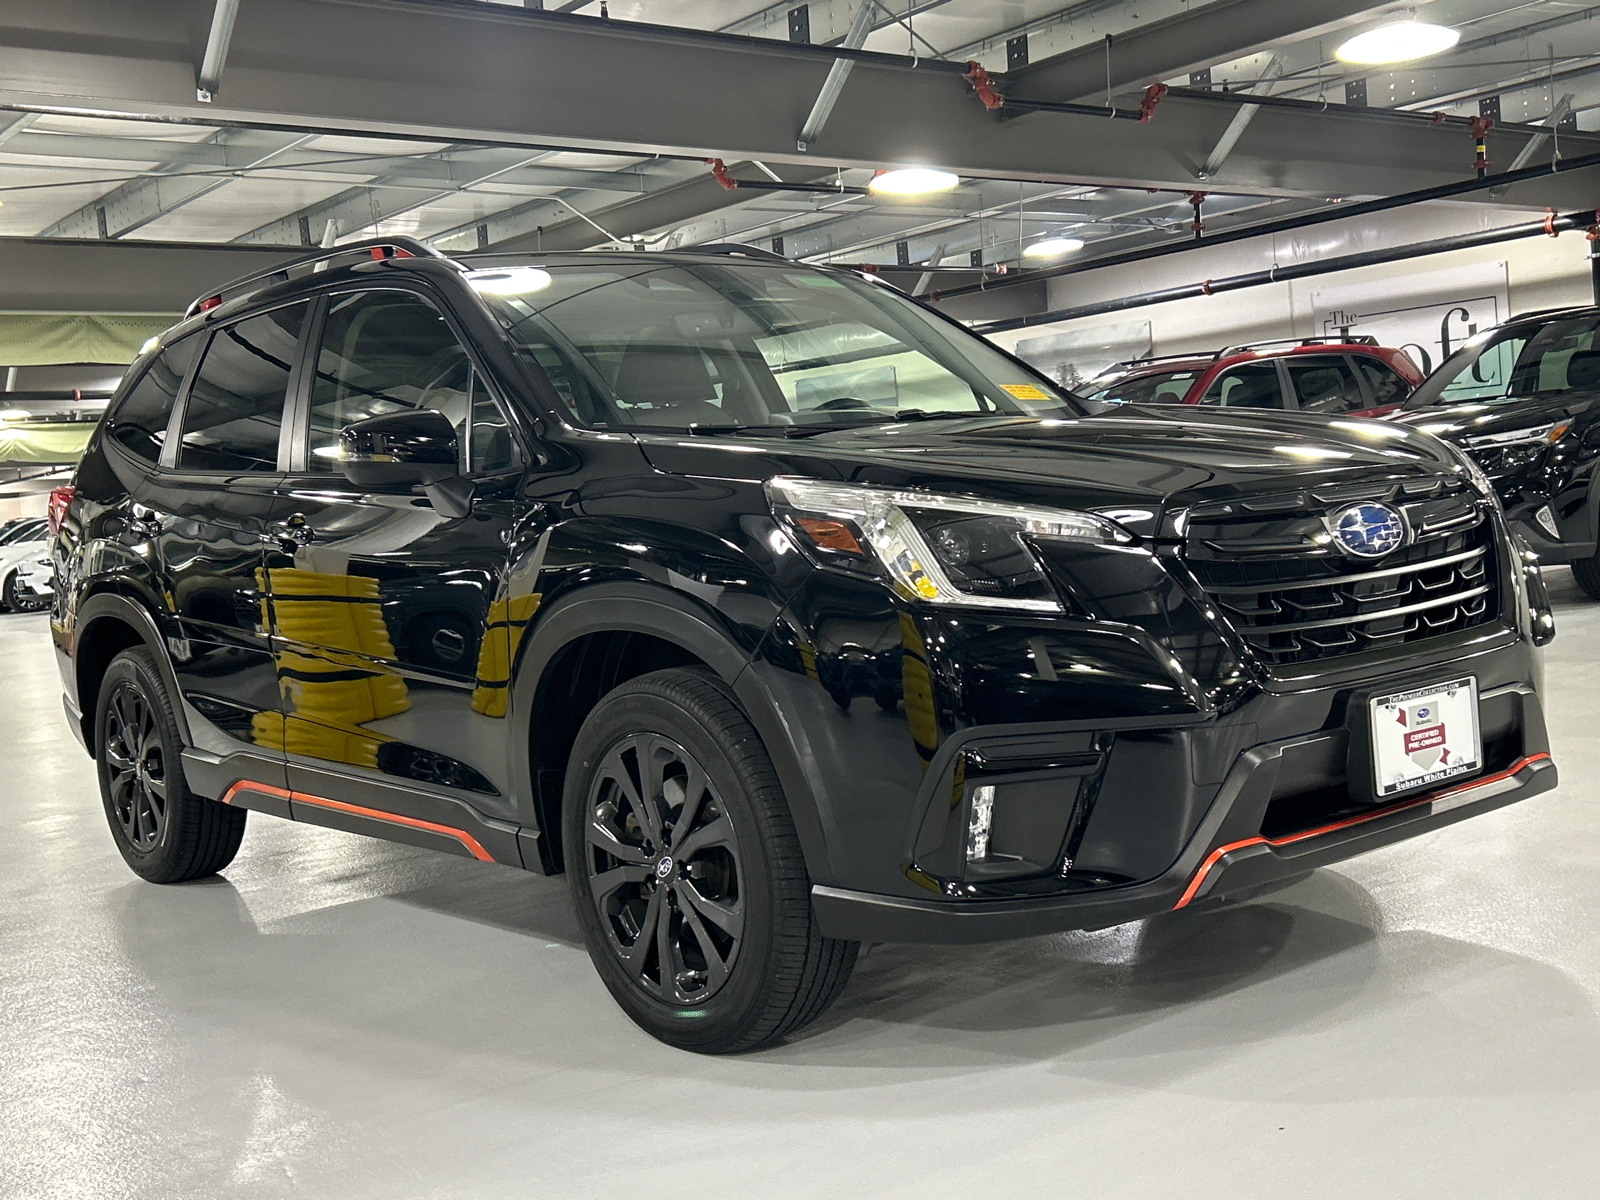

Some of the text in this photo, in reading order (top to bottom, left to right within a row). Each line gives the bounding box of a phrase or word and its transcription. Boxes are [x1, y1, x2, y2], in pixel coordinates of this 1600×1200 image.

[1329, 310, 1358, 325] The
[1410, 729, 1439, 741] CERTIFIED
[1408, 736, 1442, 749] PRE-OWNED
[1396, 765, 1468, 790] Subaru White Plains
